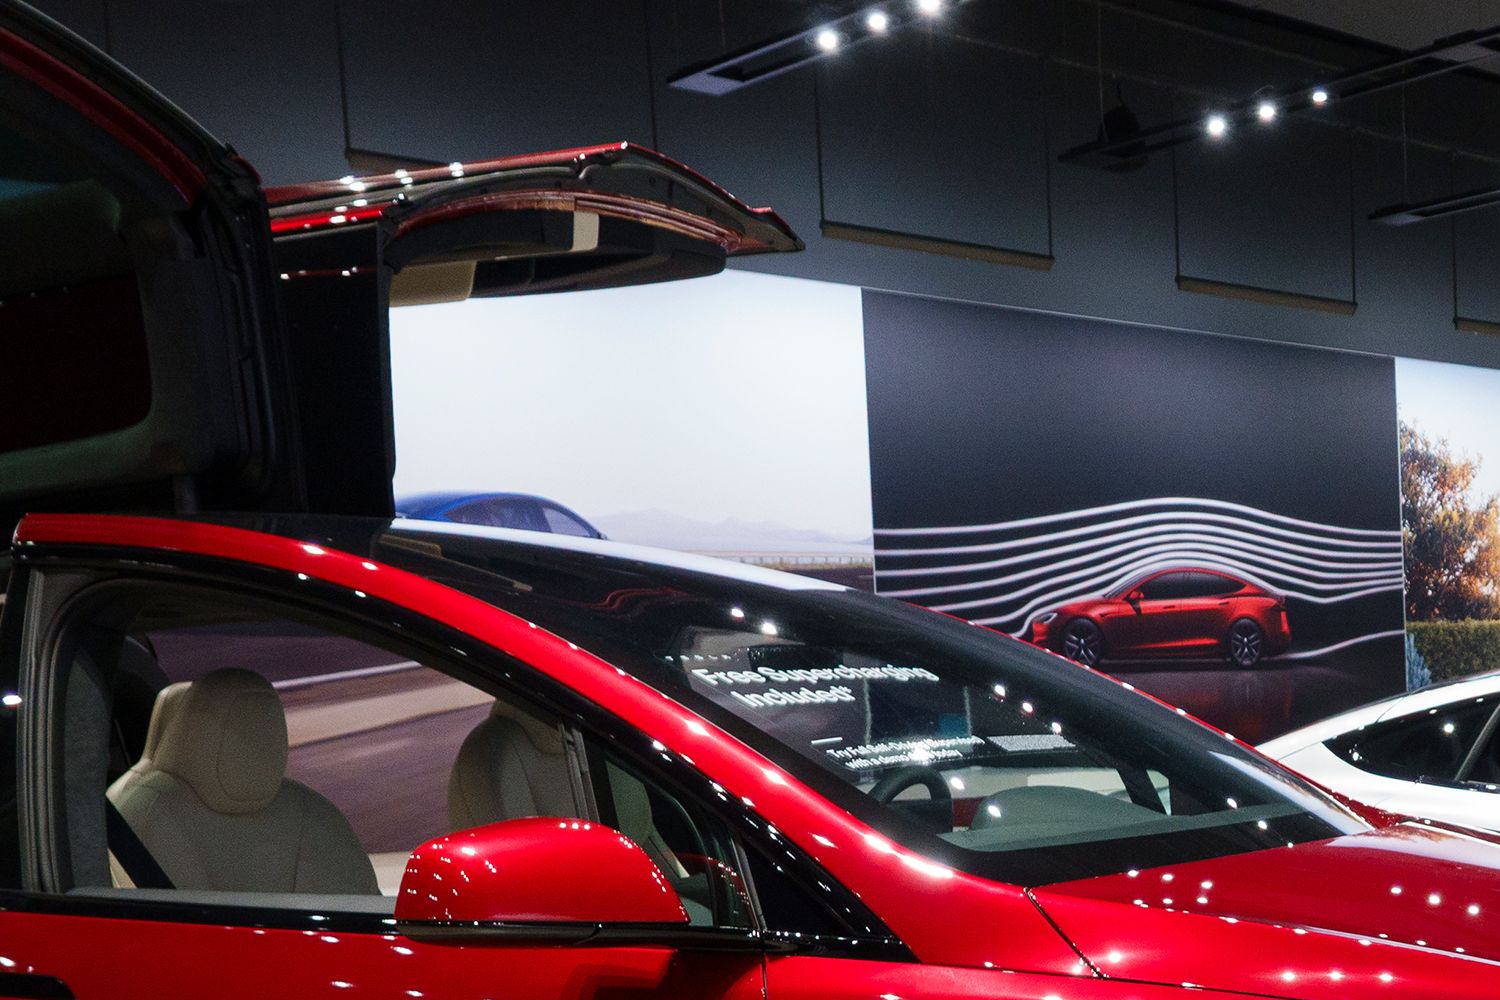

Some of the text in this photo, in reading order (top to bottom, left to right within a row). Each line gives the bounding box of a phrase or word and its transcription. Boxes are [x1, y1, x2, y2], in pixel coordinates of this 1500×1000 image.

[691, 664, 940, 686] Free Supercharging
[826, 749, 853, 758] Try
